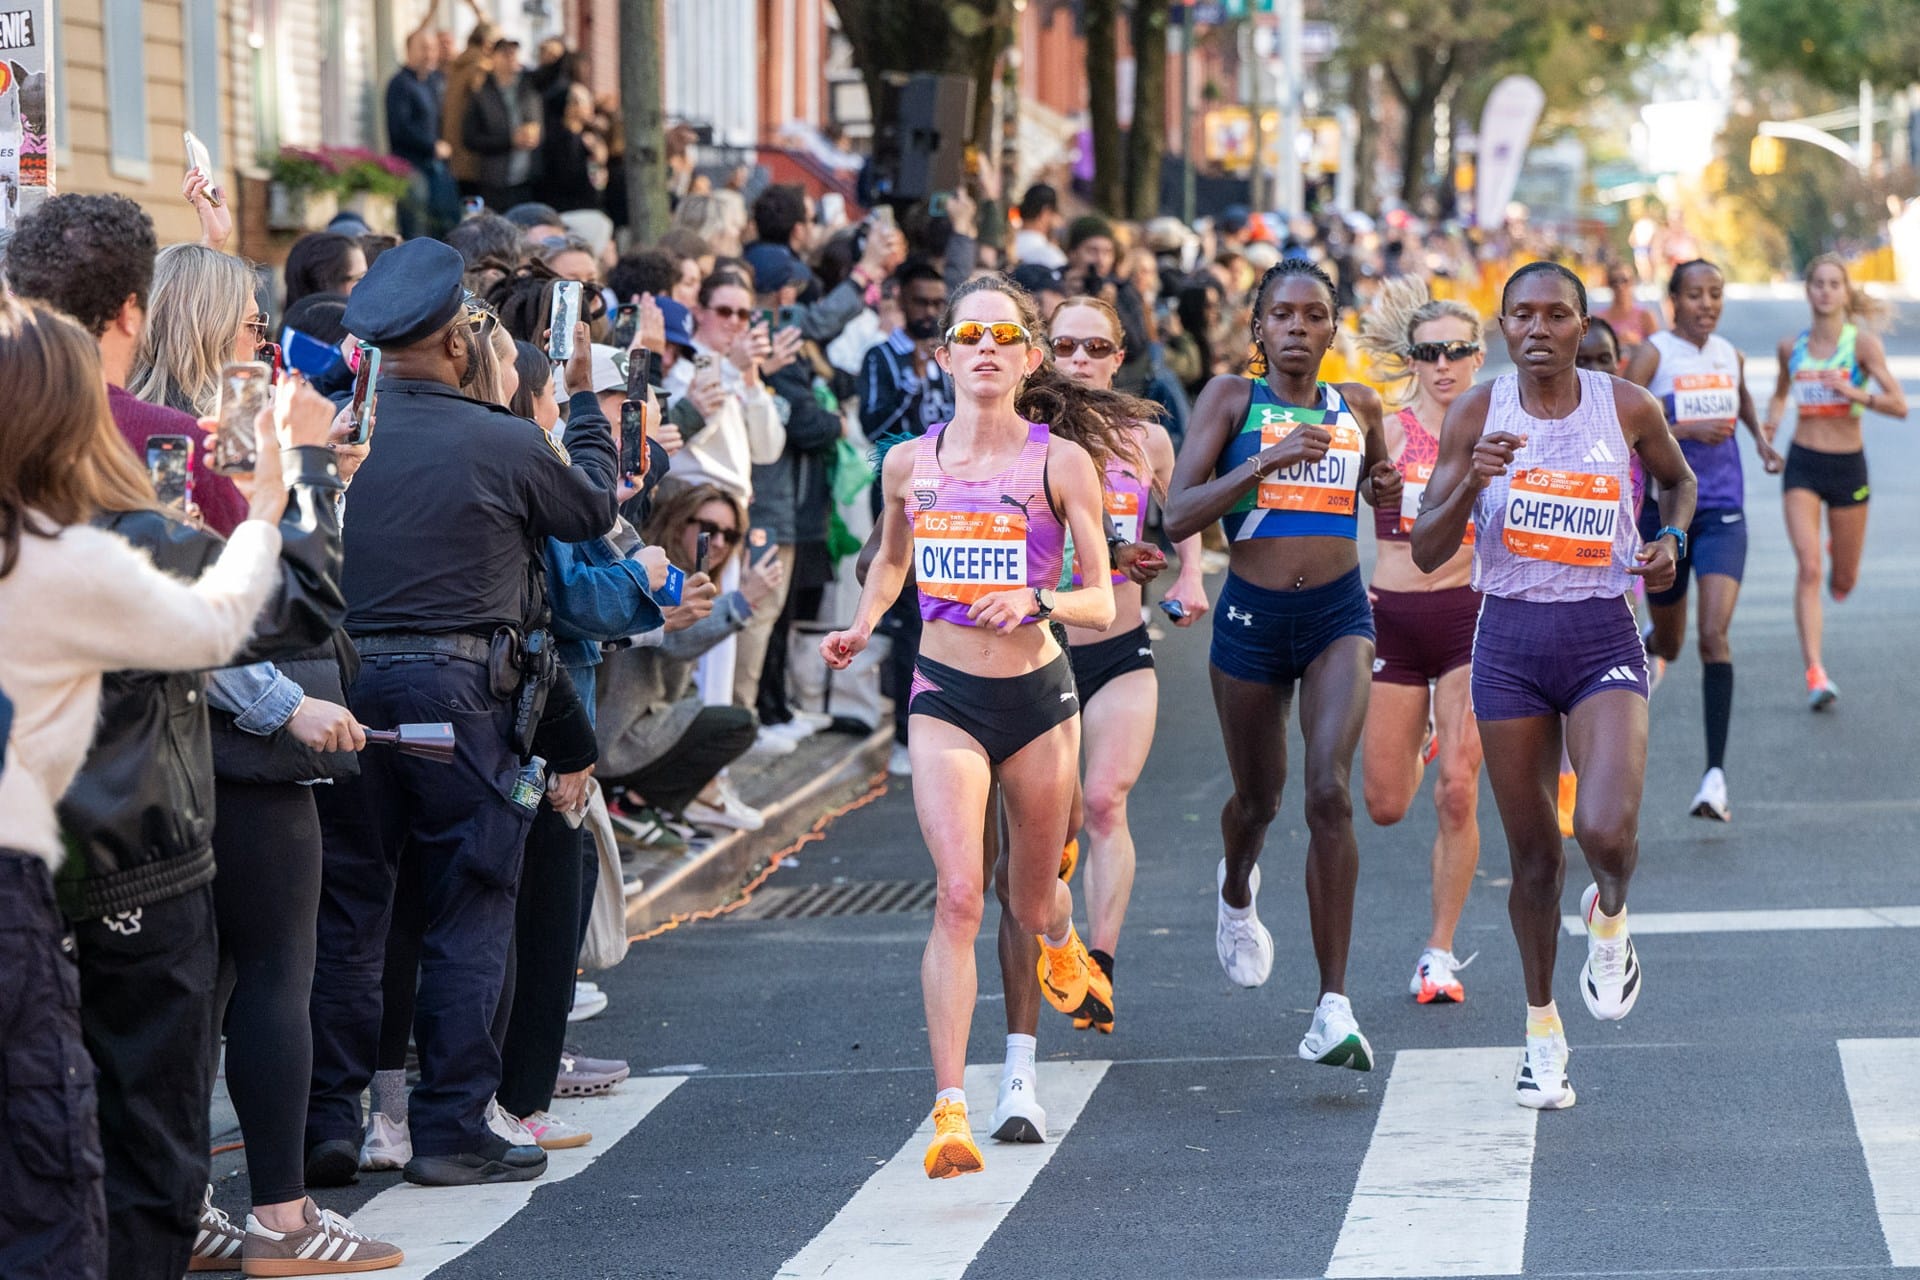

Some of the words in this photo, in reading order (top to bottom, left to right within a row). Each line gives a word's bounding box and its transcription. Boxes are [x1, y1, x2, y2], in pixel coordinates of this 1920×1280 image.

[0, 11, 30, 48] NIE
[1683, 395, 1733, 415] HASSAN
[1273, 425, 1295, 438] tc
[1526, 472, 1550, 487] tcs
[1327, 496, 1350, 506] 2025
[925, 515, 948, 530] tcs
[1510, 498, 1614, 536] CHEPKIRUI
[1576, 547, 1608, 558] 2025
[923, 546, 1018, 580] O'KEEFFE
